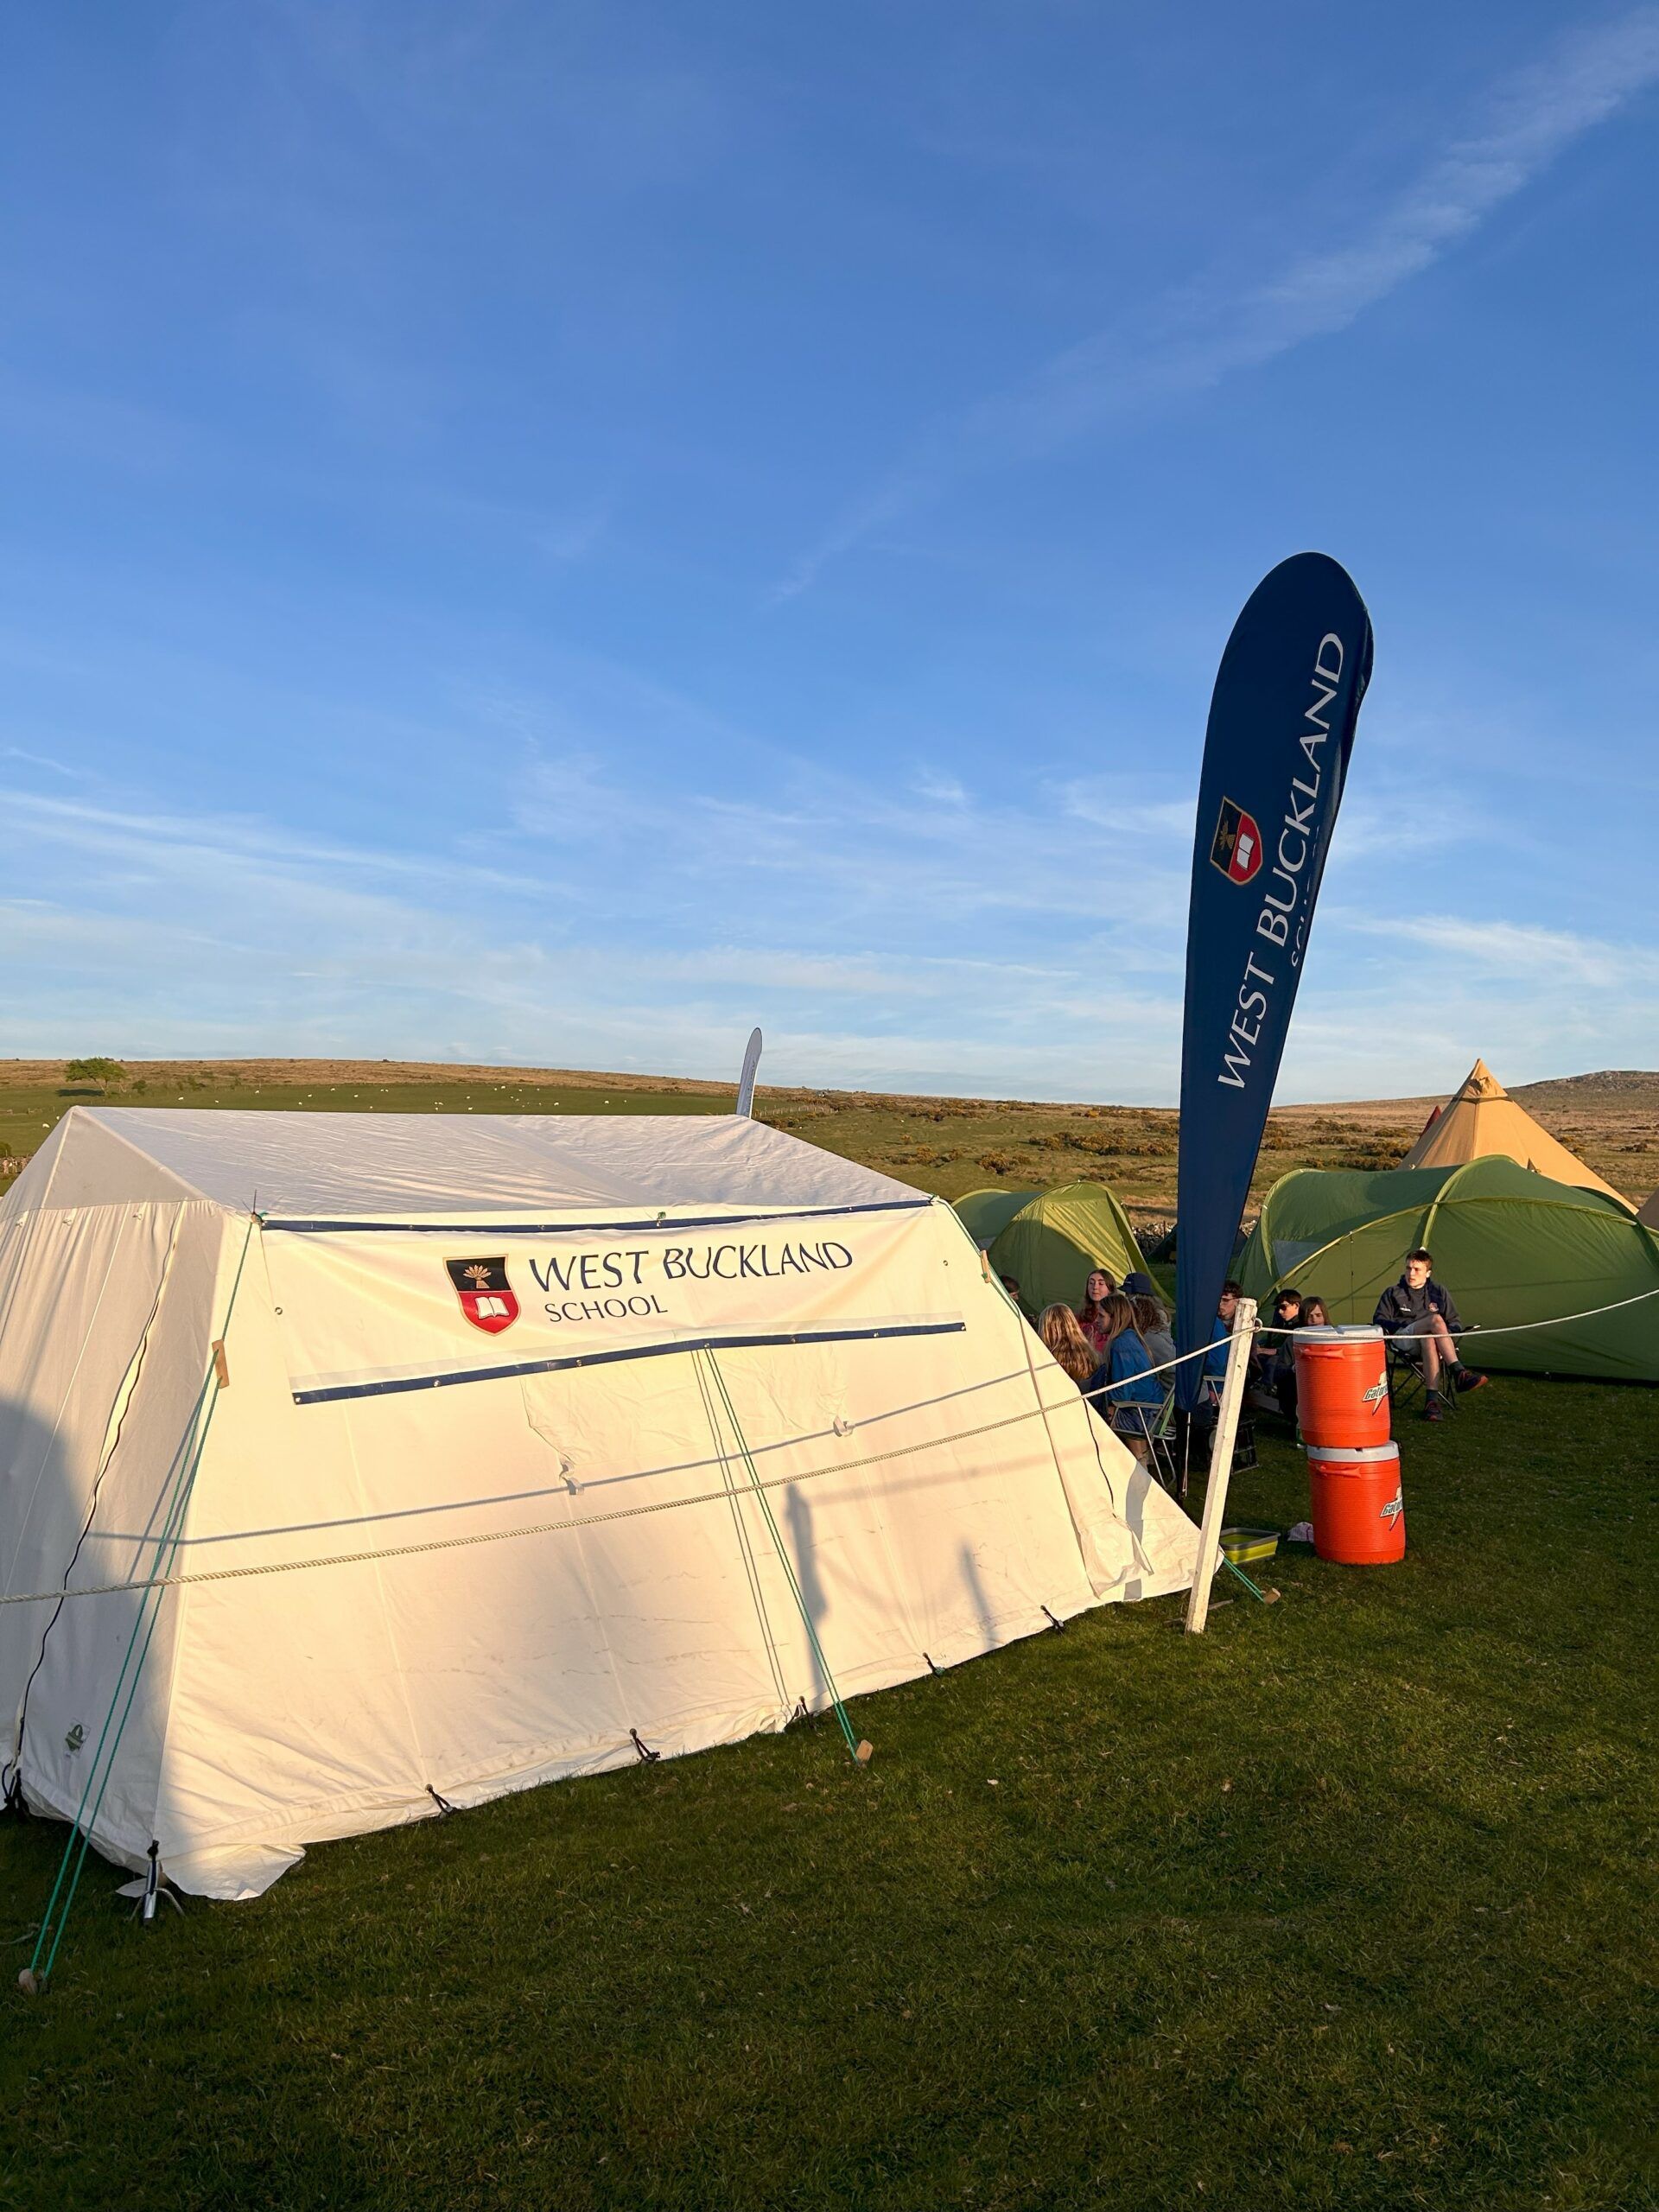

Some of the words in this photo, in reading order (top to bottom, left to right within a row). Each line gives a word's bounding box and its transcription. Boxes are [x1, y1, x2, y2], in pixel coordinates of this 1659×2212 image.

[1217, 950, 1274, 1089] WEST
[1255, 632, 1344, 947] BUCKLAND
[529, 1250, 650, 1292] WEST
[663, 1242, 853, 1280] BUCKLAND
[544, 1294, 668, 1323] SCHOOL
